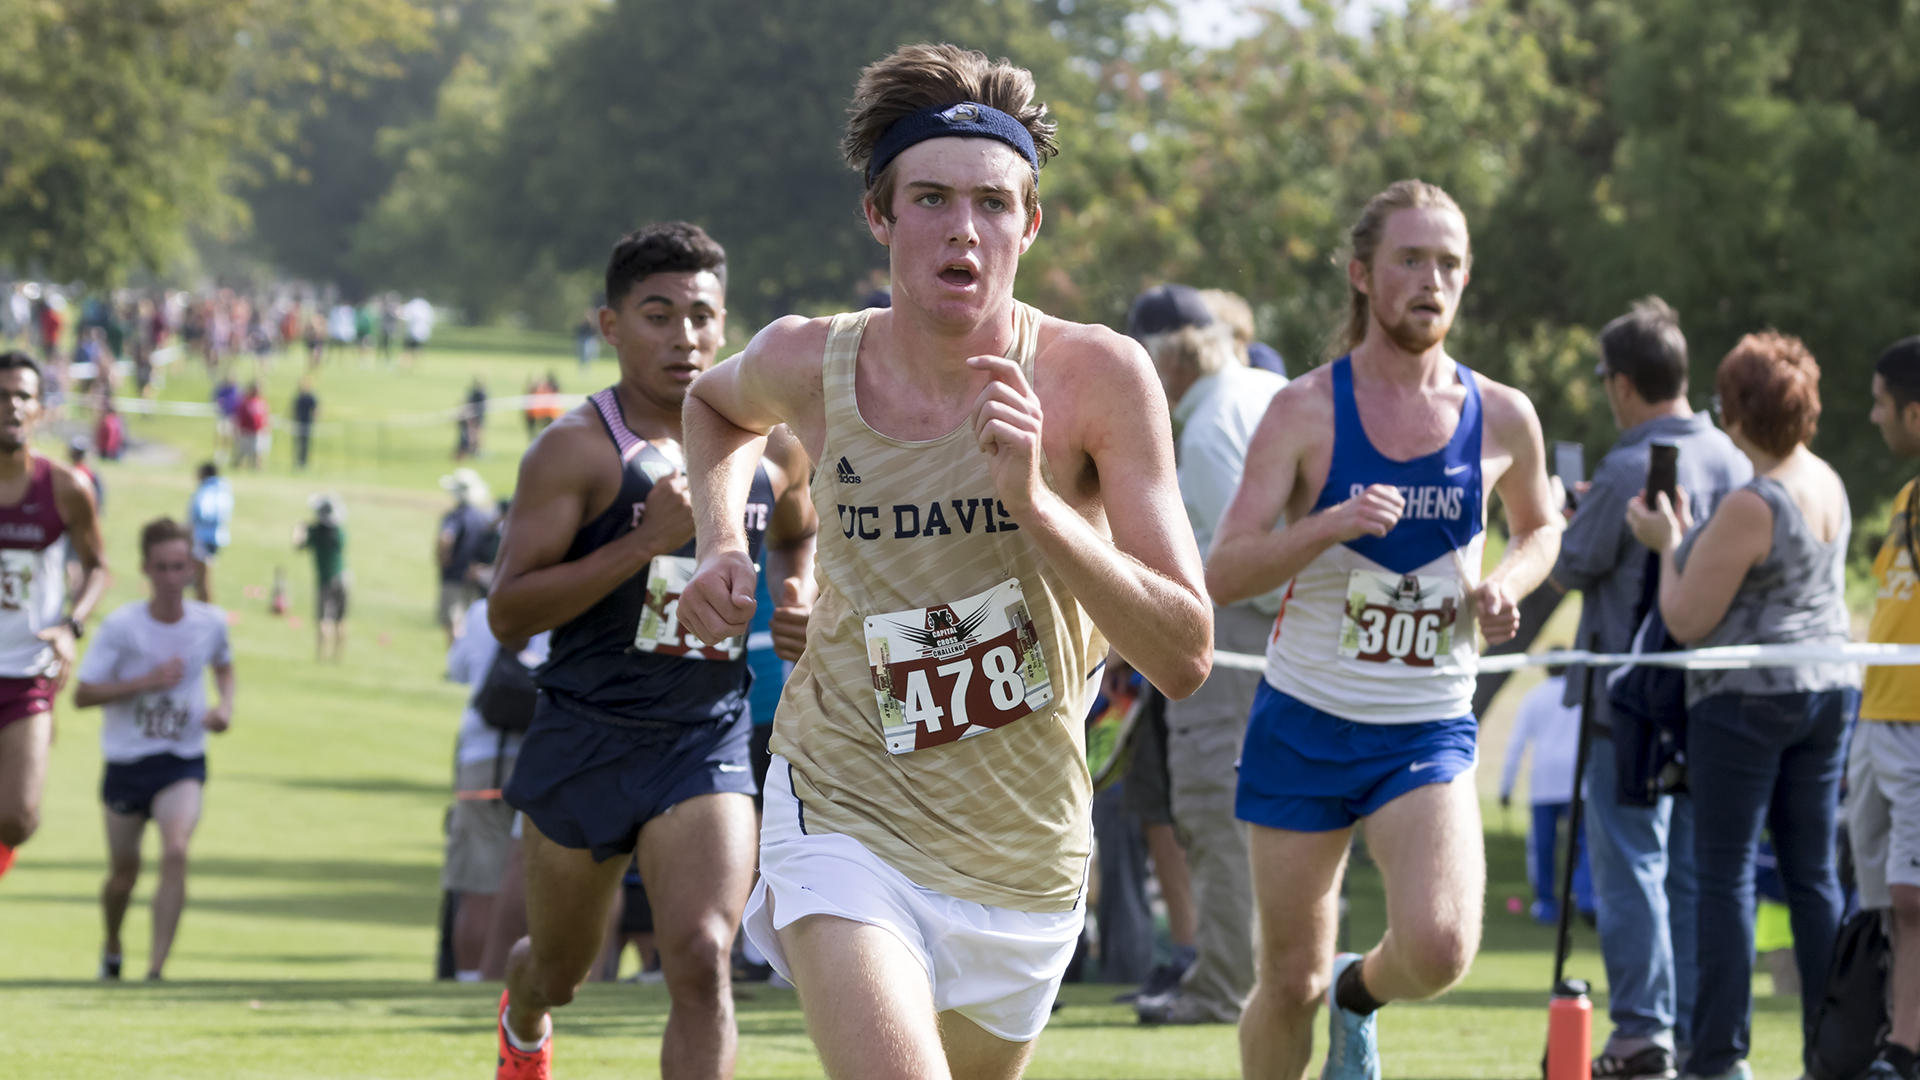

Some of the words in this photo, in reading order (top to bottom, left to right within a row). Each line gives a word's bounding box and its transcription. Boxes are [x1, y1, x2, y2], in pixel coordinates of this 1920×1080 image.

[1350, 483, 1464, 520] SHENS
[837, 504, 881, 540] UC
[932, 627, 957, 638] CAPITAL
[933, 644, 967, 657] CHALLENGE
[937, 637, 958, 647] CROSS
[1359, 609, 1440, 660] 306
[905, 645, 1025, 733] 478
